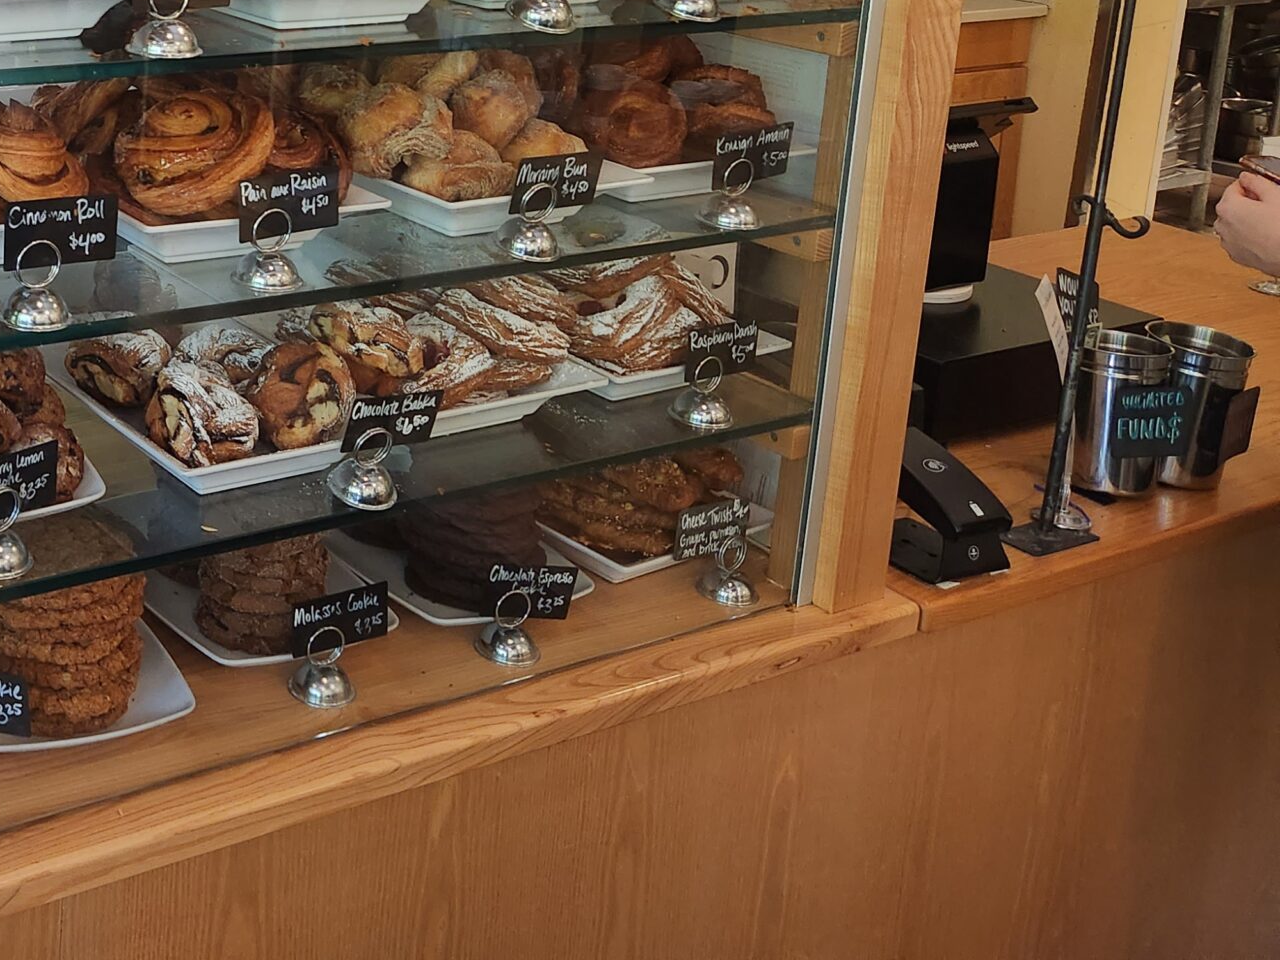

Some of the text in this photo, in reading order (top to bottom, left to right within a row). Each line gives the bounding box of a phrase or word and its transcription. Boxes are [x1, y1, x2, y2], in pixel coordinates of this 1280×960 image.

[516, 157, 588, 188] Morning Bun
[240, 172, 327, 206] Pain aux Raisin
[8, 198, 105, 229] Cinnamon Roll
[689, 328, 734, 353] Raspberry
[352, 394, 437, 420] Chocolate Babka
[16, 450, 45, 468] Lemon
[681, 511, 708, 530] Cheese
[489, 564, 574, 588] Chocolate Espresso
[294, 591, 379, 627] Molasses Cookie
